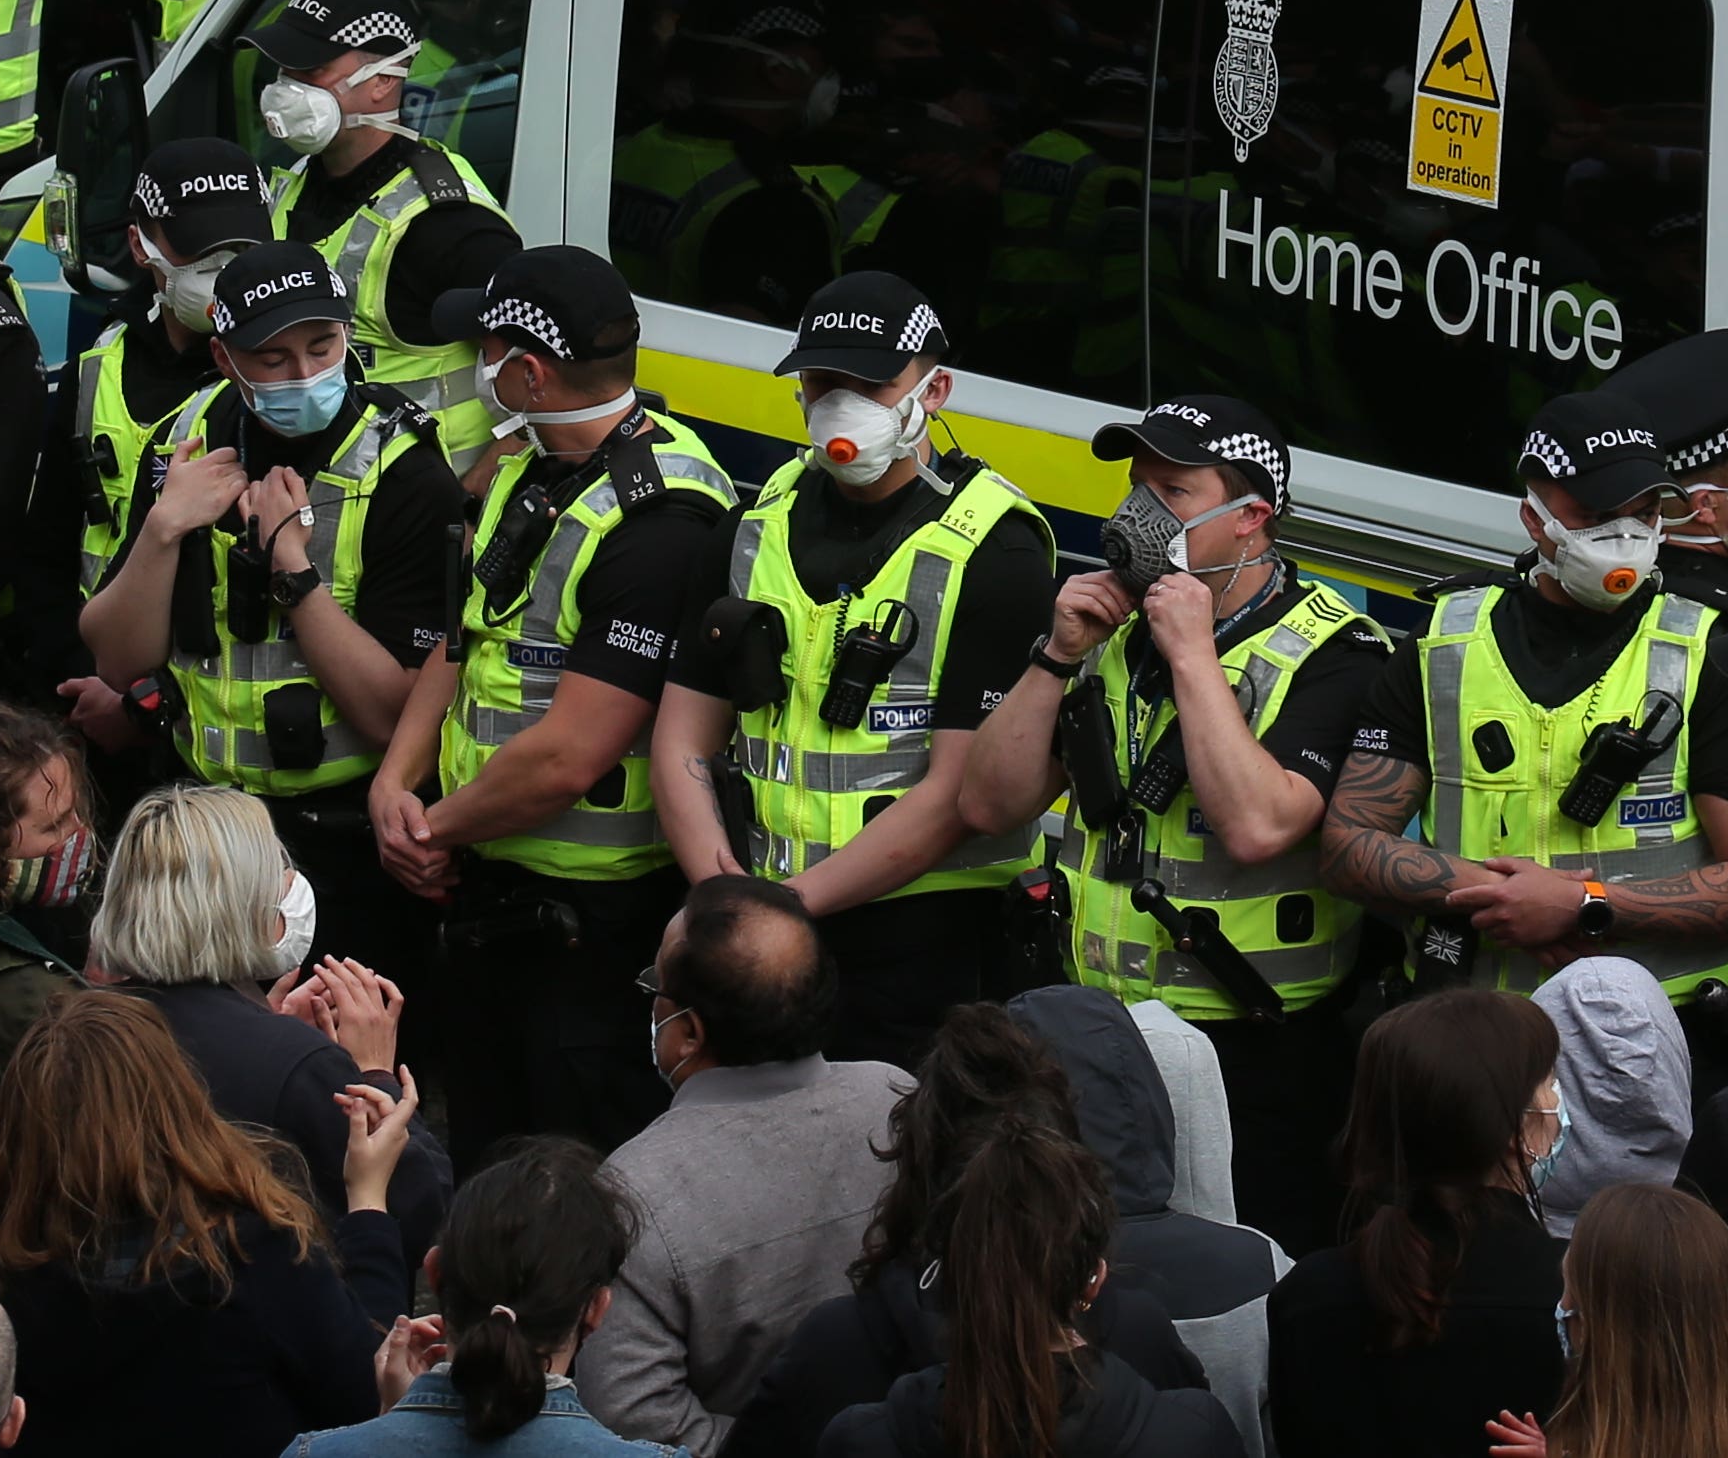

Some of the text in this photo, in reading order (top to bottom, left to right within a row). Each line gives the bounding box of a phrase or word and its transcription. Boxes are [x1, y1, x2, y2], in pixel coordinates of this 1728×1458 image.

[1432, 106, 1483, 139] CCTV
[1448, 137, 1463, 160] in
[180, 174, 250, 197] POLICE
[1416, 160, 1491, 191] operation
[243, 271, 316, 307] POLICE
[1217, 188, 1622, 369] Home Office
[812, 312, 885, 335] POLICE
[1585, 428, 1657, 454] POLICE
[633, 472, 643, 483] U
[629, 482, 655, 502] 312
[943, 514, 977, 536] 1164
[964, 509, 975, 520] G
[611, 619, 666, 647] POLICE
[1288, 619, 1317, 640] 1199
[512, 648, 565, 665] POLIC
[606, 632, 660, 660] SCOTLAND
[1624, 799, 1682, 821] POLICE
